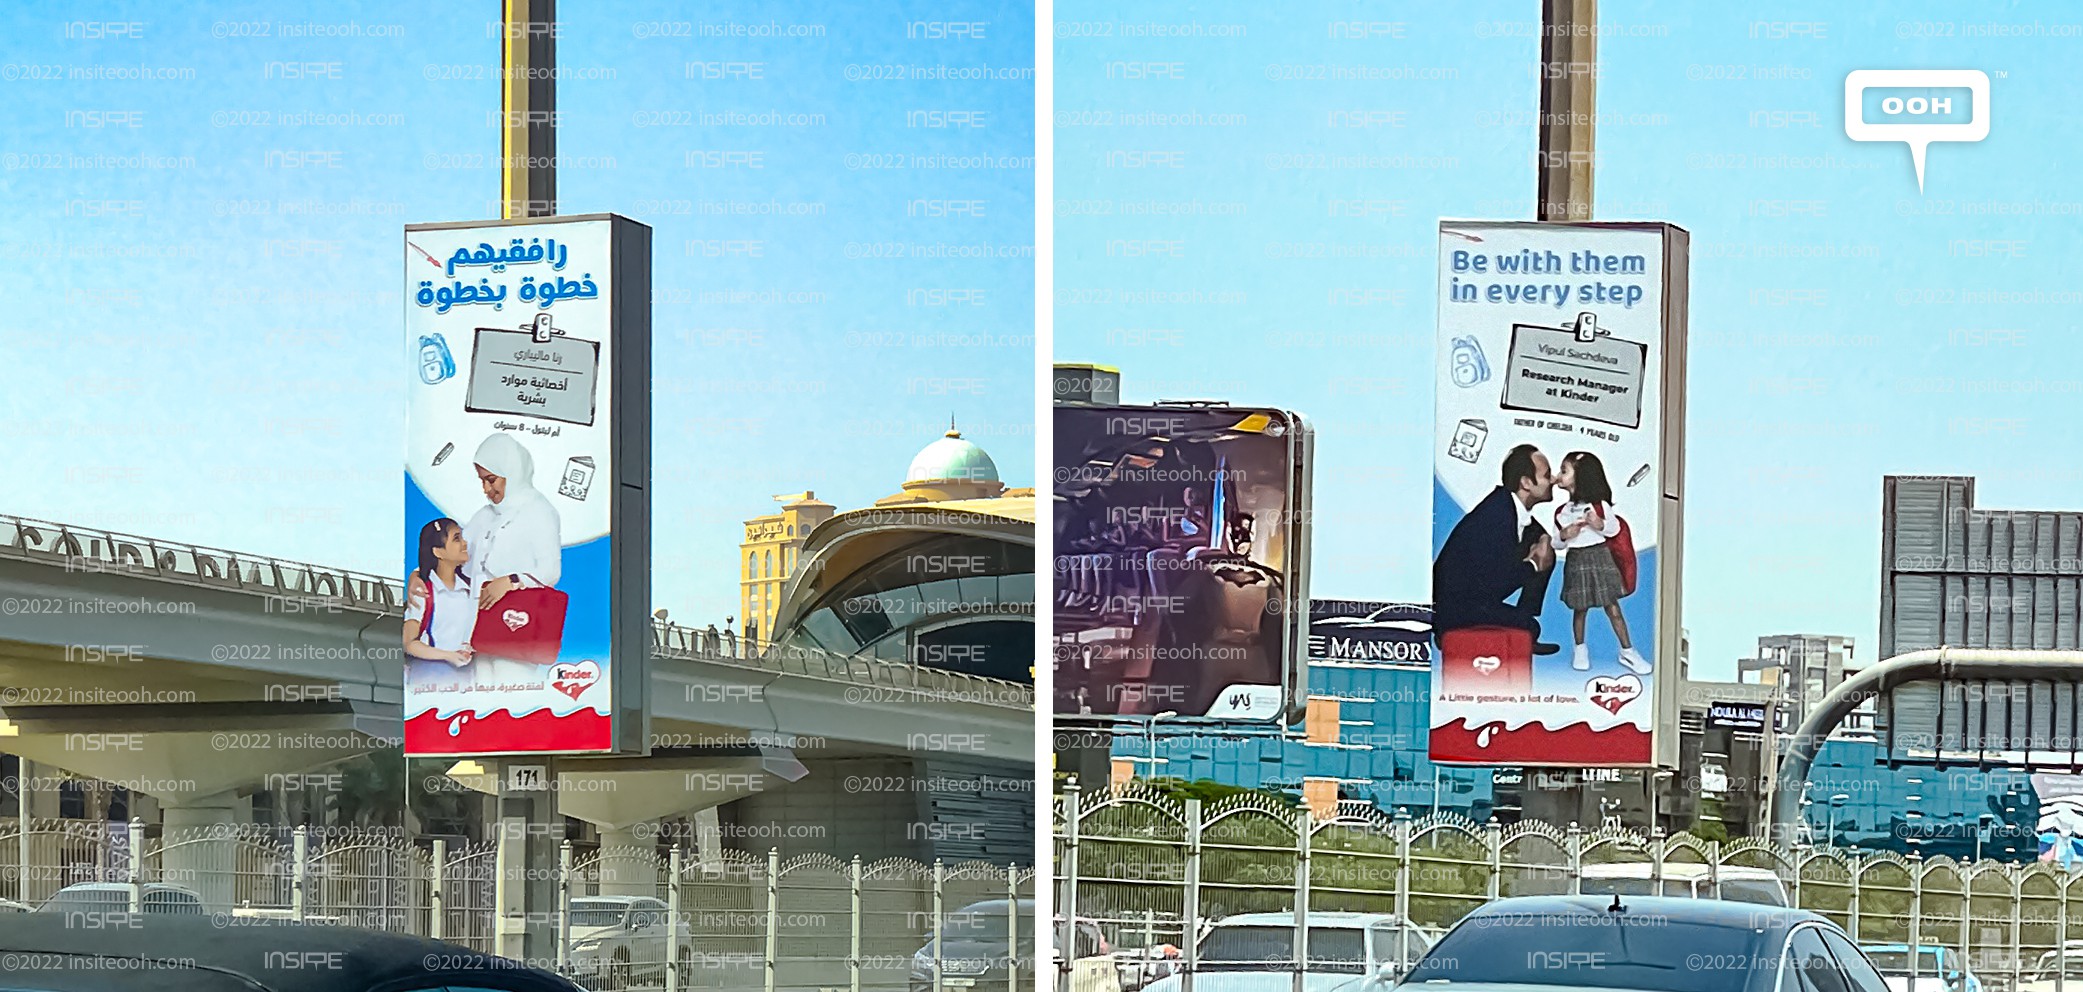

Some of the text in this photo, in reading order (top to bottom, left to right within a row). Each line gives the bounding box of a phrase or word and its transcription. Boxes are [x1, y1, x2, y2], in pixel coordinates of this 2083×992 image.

[446, 237, 568, 277] رافقيهم
[1452, 249, 1646, 275] Be with them
[416, 273, 599, 314] خطوة بخطوة
[1451, 277, 1643, 309] in every step
[1538, 343, 1565, 356] Vipul
[501, 374, 568, 391] أخصائية موارد
[1521, 368, 1629, 394] Research Manager
[517, 391, 546, 407] بشرية
[1545, 387, 1600, 403] at Kinder
[516, 769, 538, 786] 171
